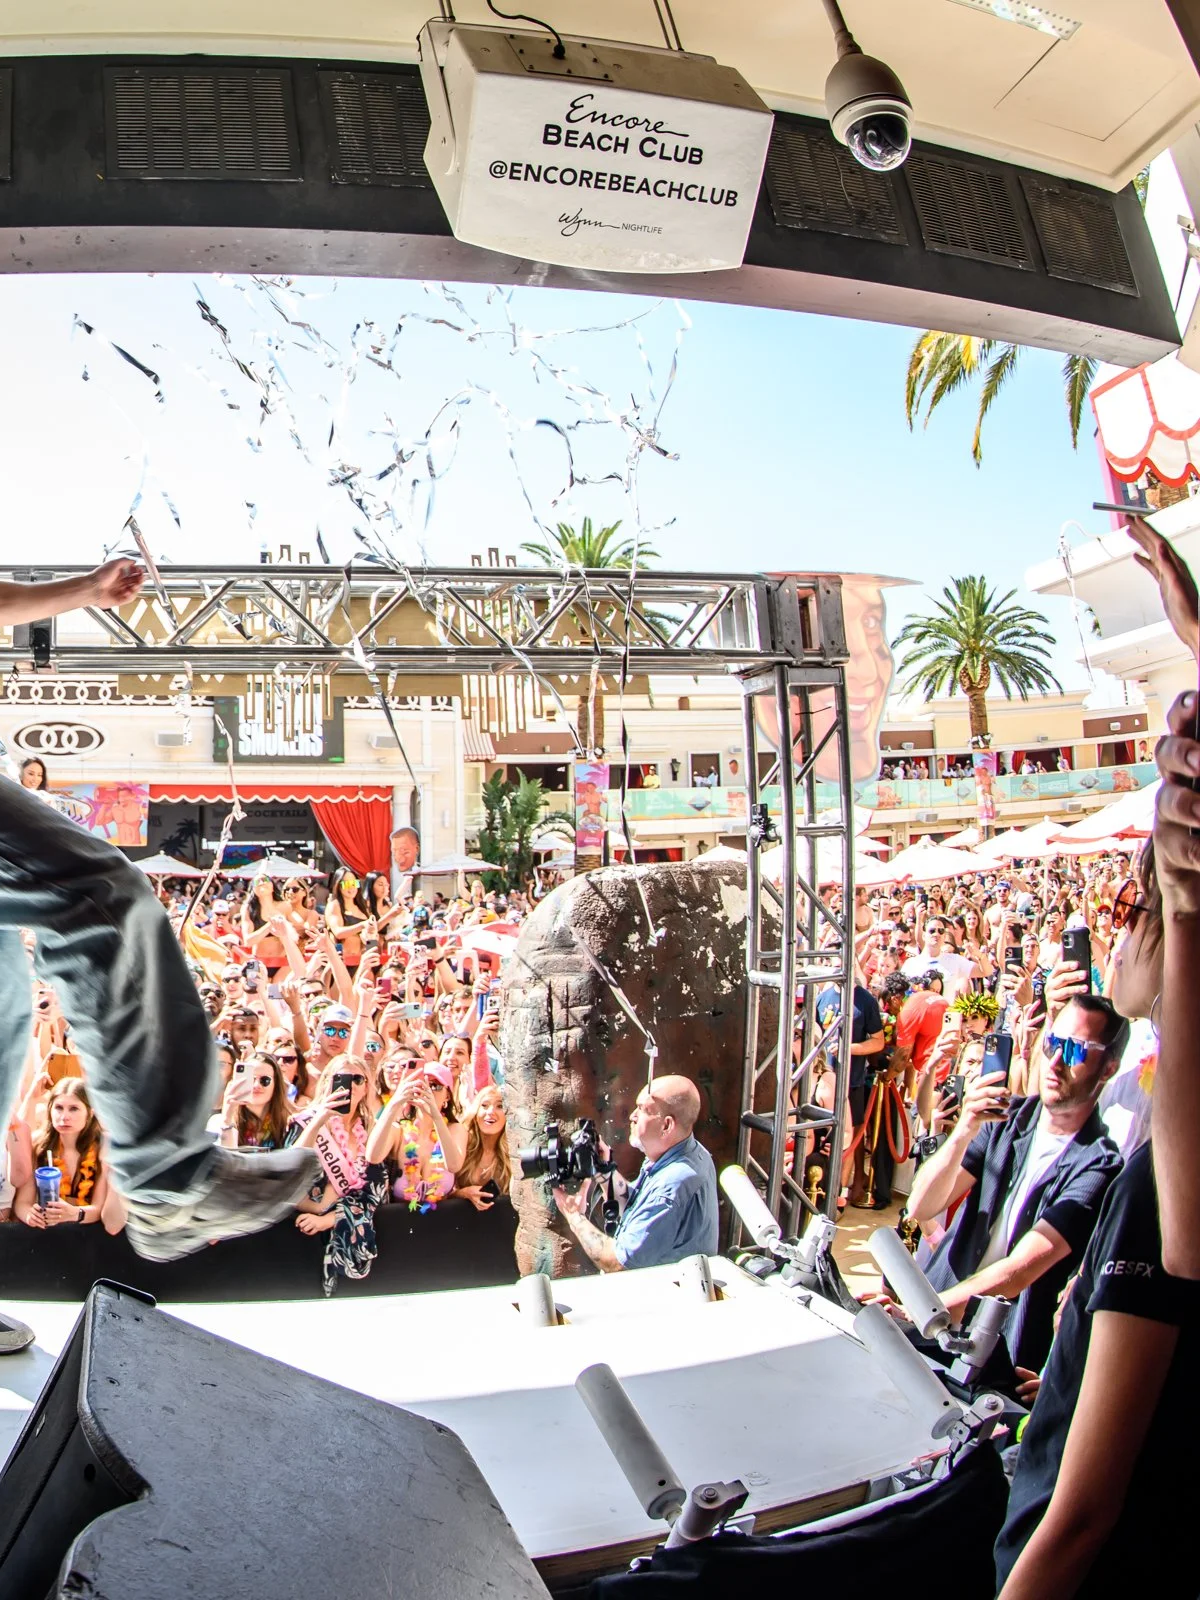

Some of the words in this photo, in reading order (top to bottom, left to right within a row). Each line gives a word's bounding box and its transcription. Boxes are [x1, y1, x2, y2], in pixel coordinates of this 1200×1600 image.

[565, 94, 690, 138] Encore
[542, 123, 630, 155] BEACH
[638, 136, 704, 166] CLUB
[488, 160, 739, 208] @ENCOREBEACHCLUB
[621, 222, 663, 235] NIGHTLIFE
[247, 808, 309, 818] COCKTAILS
